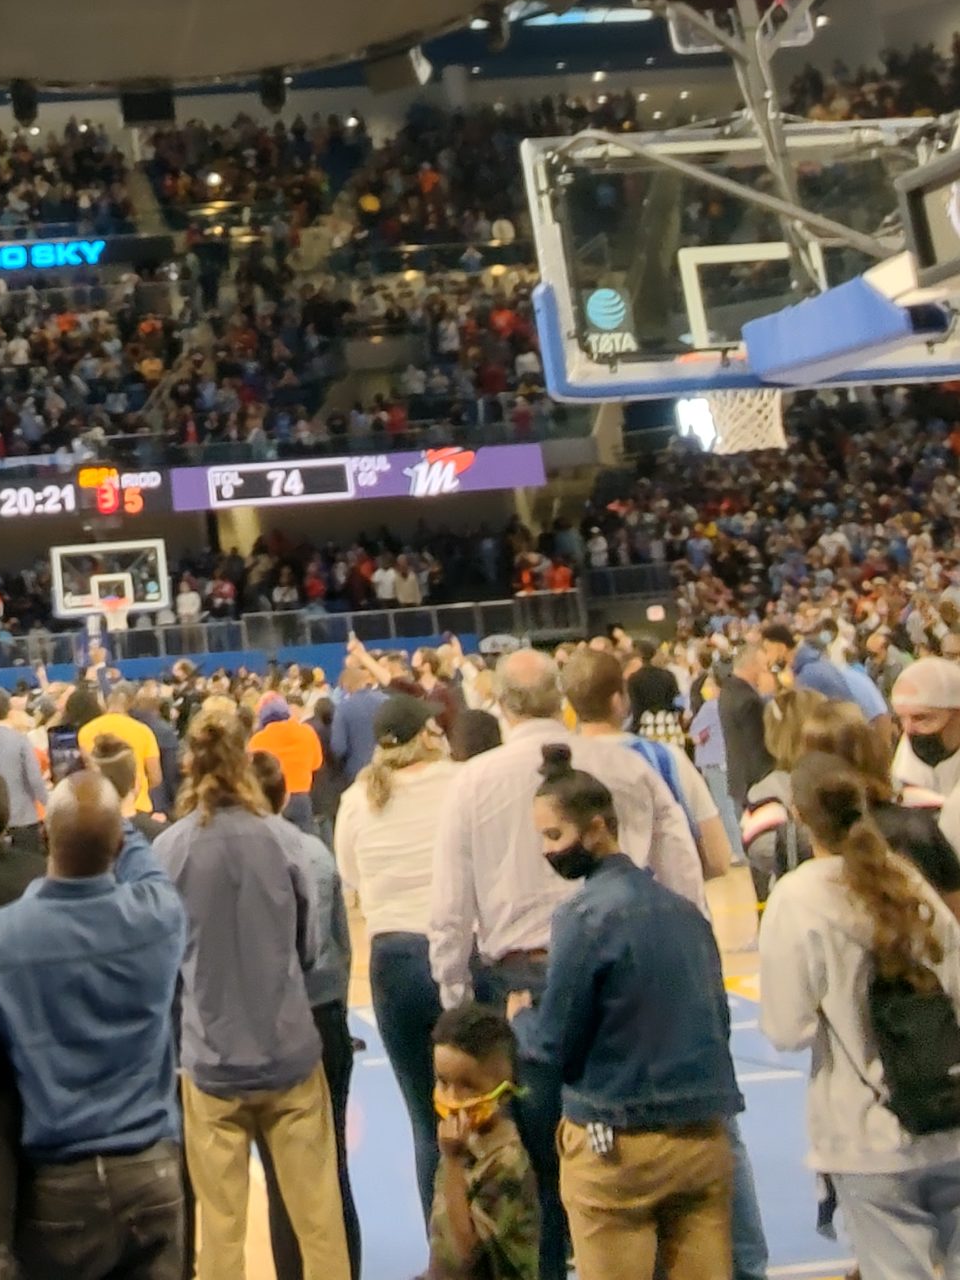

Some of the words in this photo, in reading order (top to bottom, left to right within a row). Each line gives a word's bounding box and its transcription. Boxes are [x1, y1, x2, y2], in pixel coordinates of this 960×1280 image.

[31, 239, 106, 267] SKY
[266, 468, 305, 498] 74
[123, 487, 144, 514] 5
